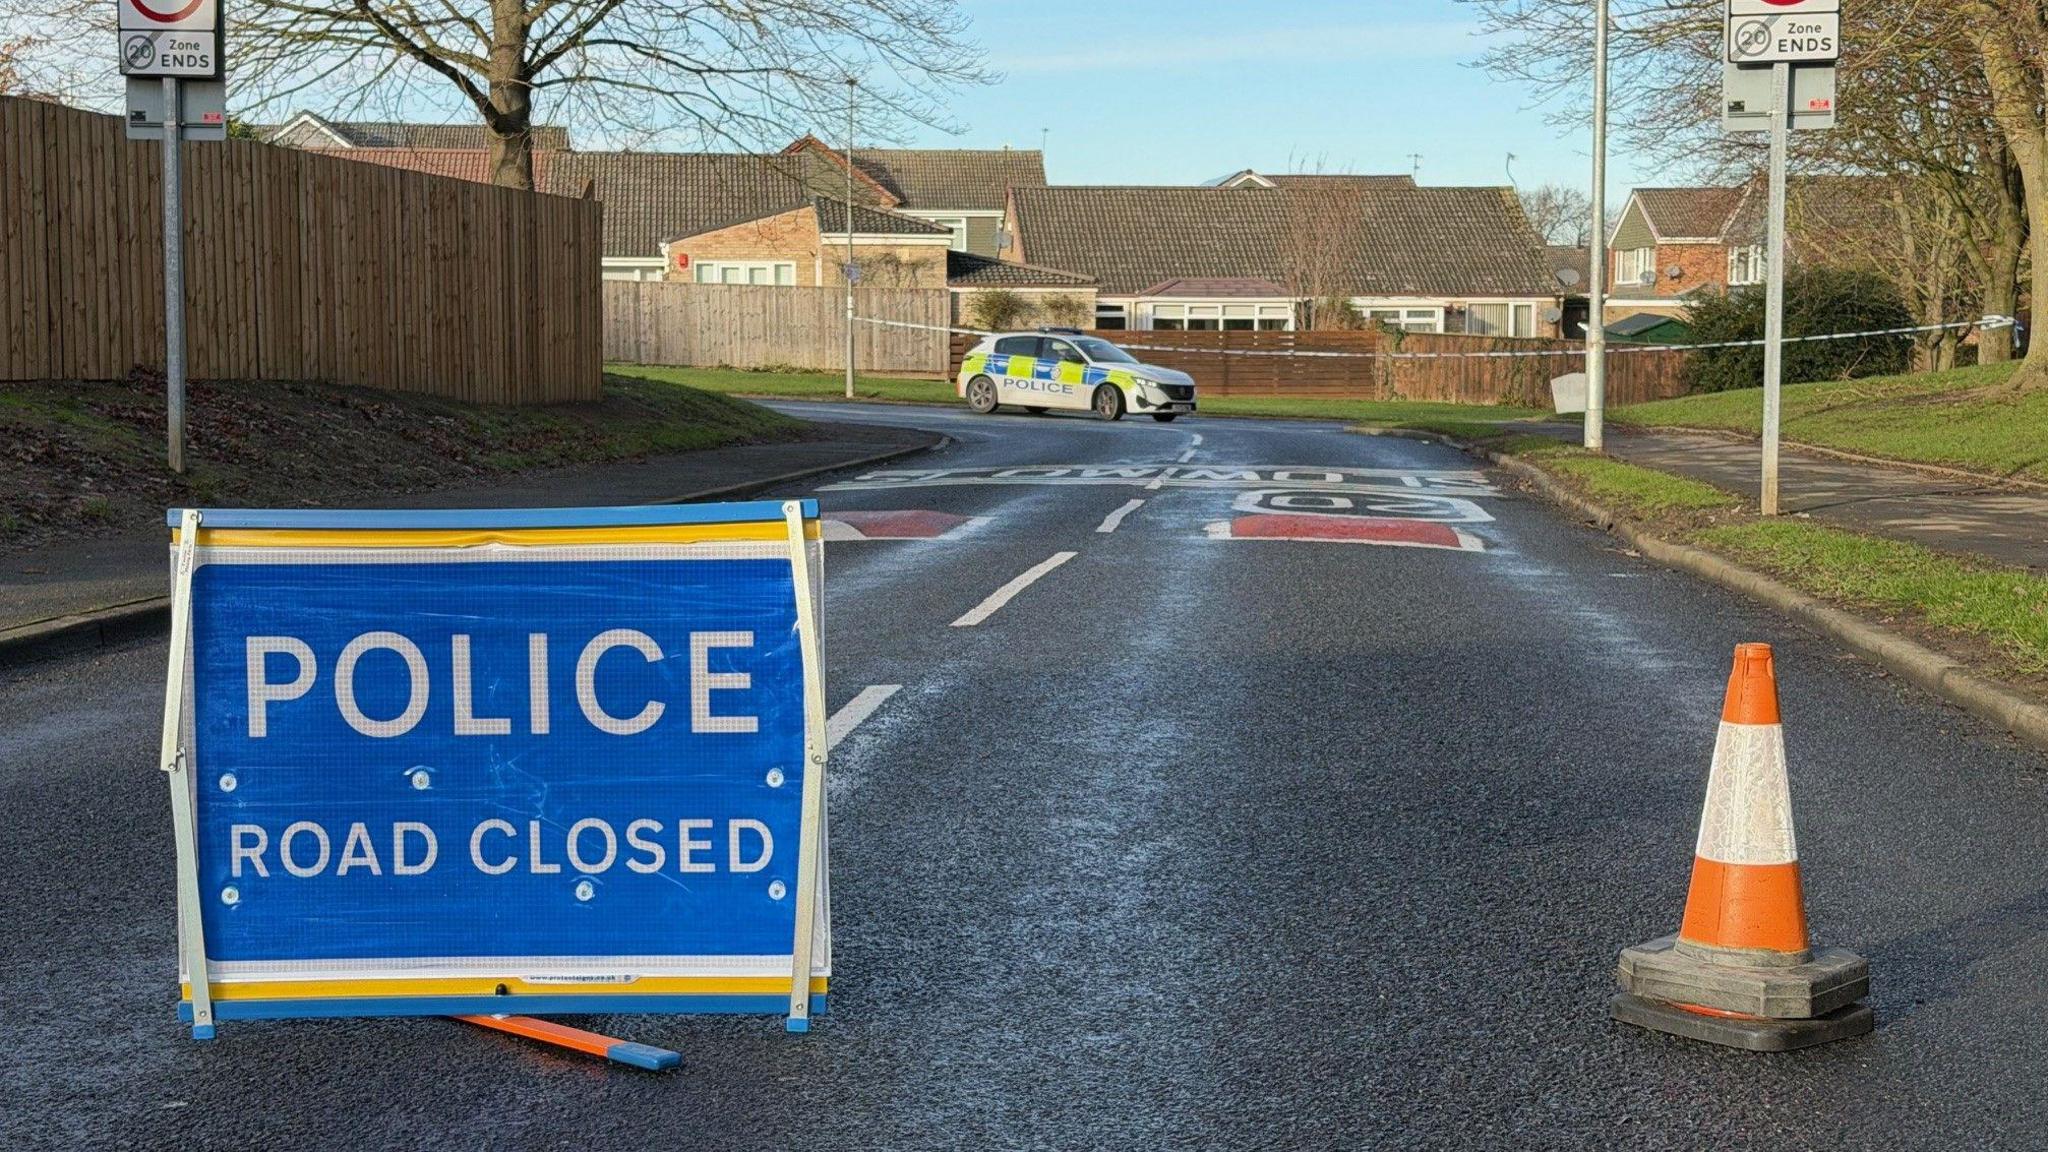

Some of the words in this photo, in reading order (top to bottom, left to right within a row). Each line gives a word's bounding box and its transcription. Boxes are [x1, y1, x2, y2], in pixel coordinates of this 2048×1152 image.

[1788, 23, 1822, 34] Zone
[169, 39, 200, 51] Zone
[1741, 30, 1766, 45] 20
[1778, 37, 1832, 52] ENDS
[130, 45, 151, 59] 20
[161, 54, 209, 68] ENDS
[1003, 378, 1073, 394] POLICE
[1270, 495, 1450, 514] 20
[245, 628, 758, 738] POLICE
[231, 821, 438, 877] ROAD
[470, 818, 774, 874] CLOSED
